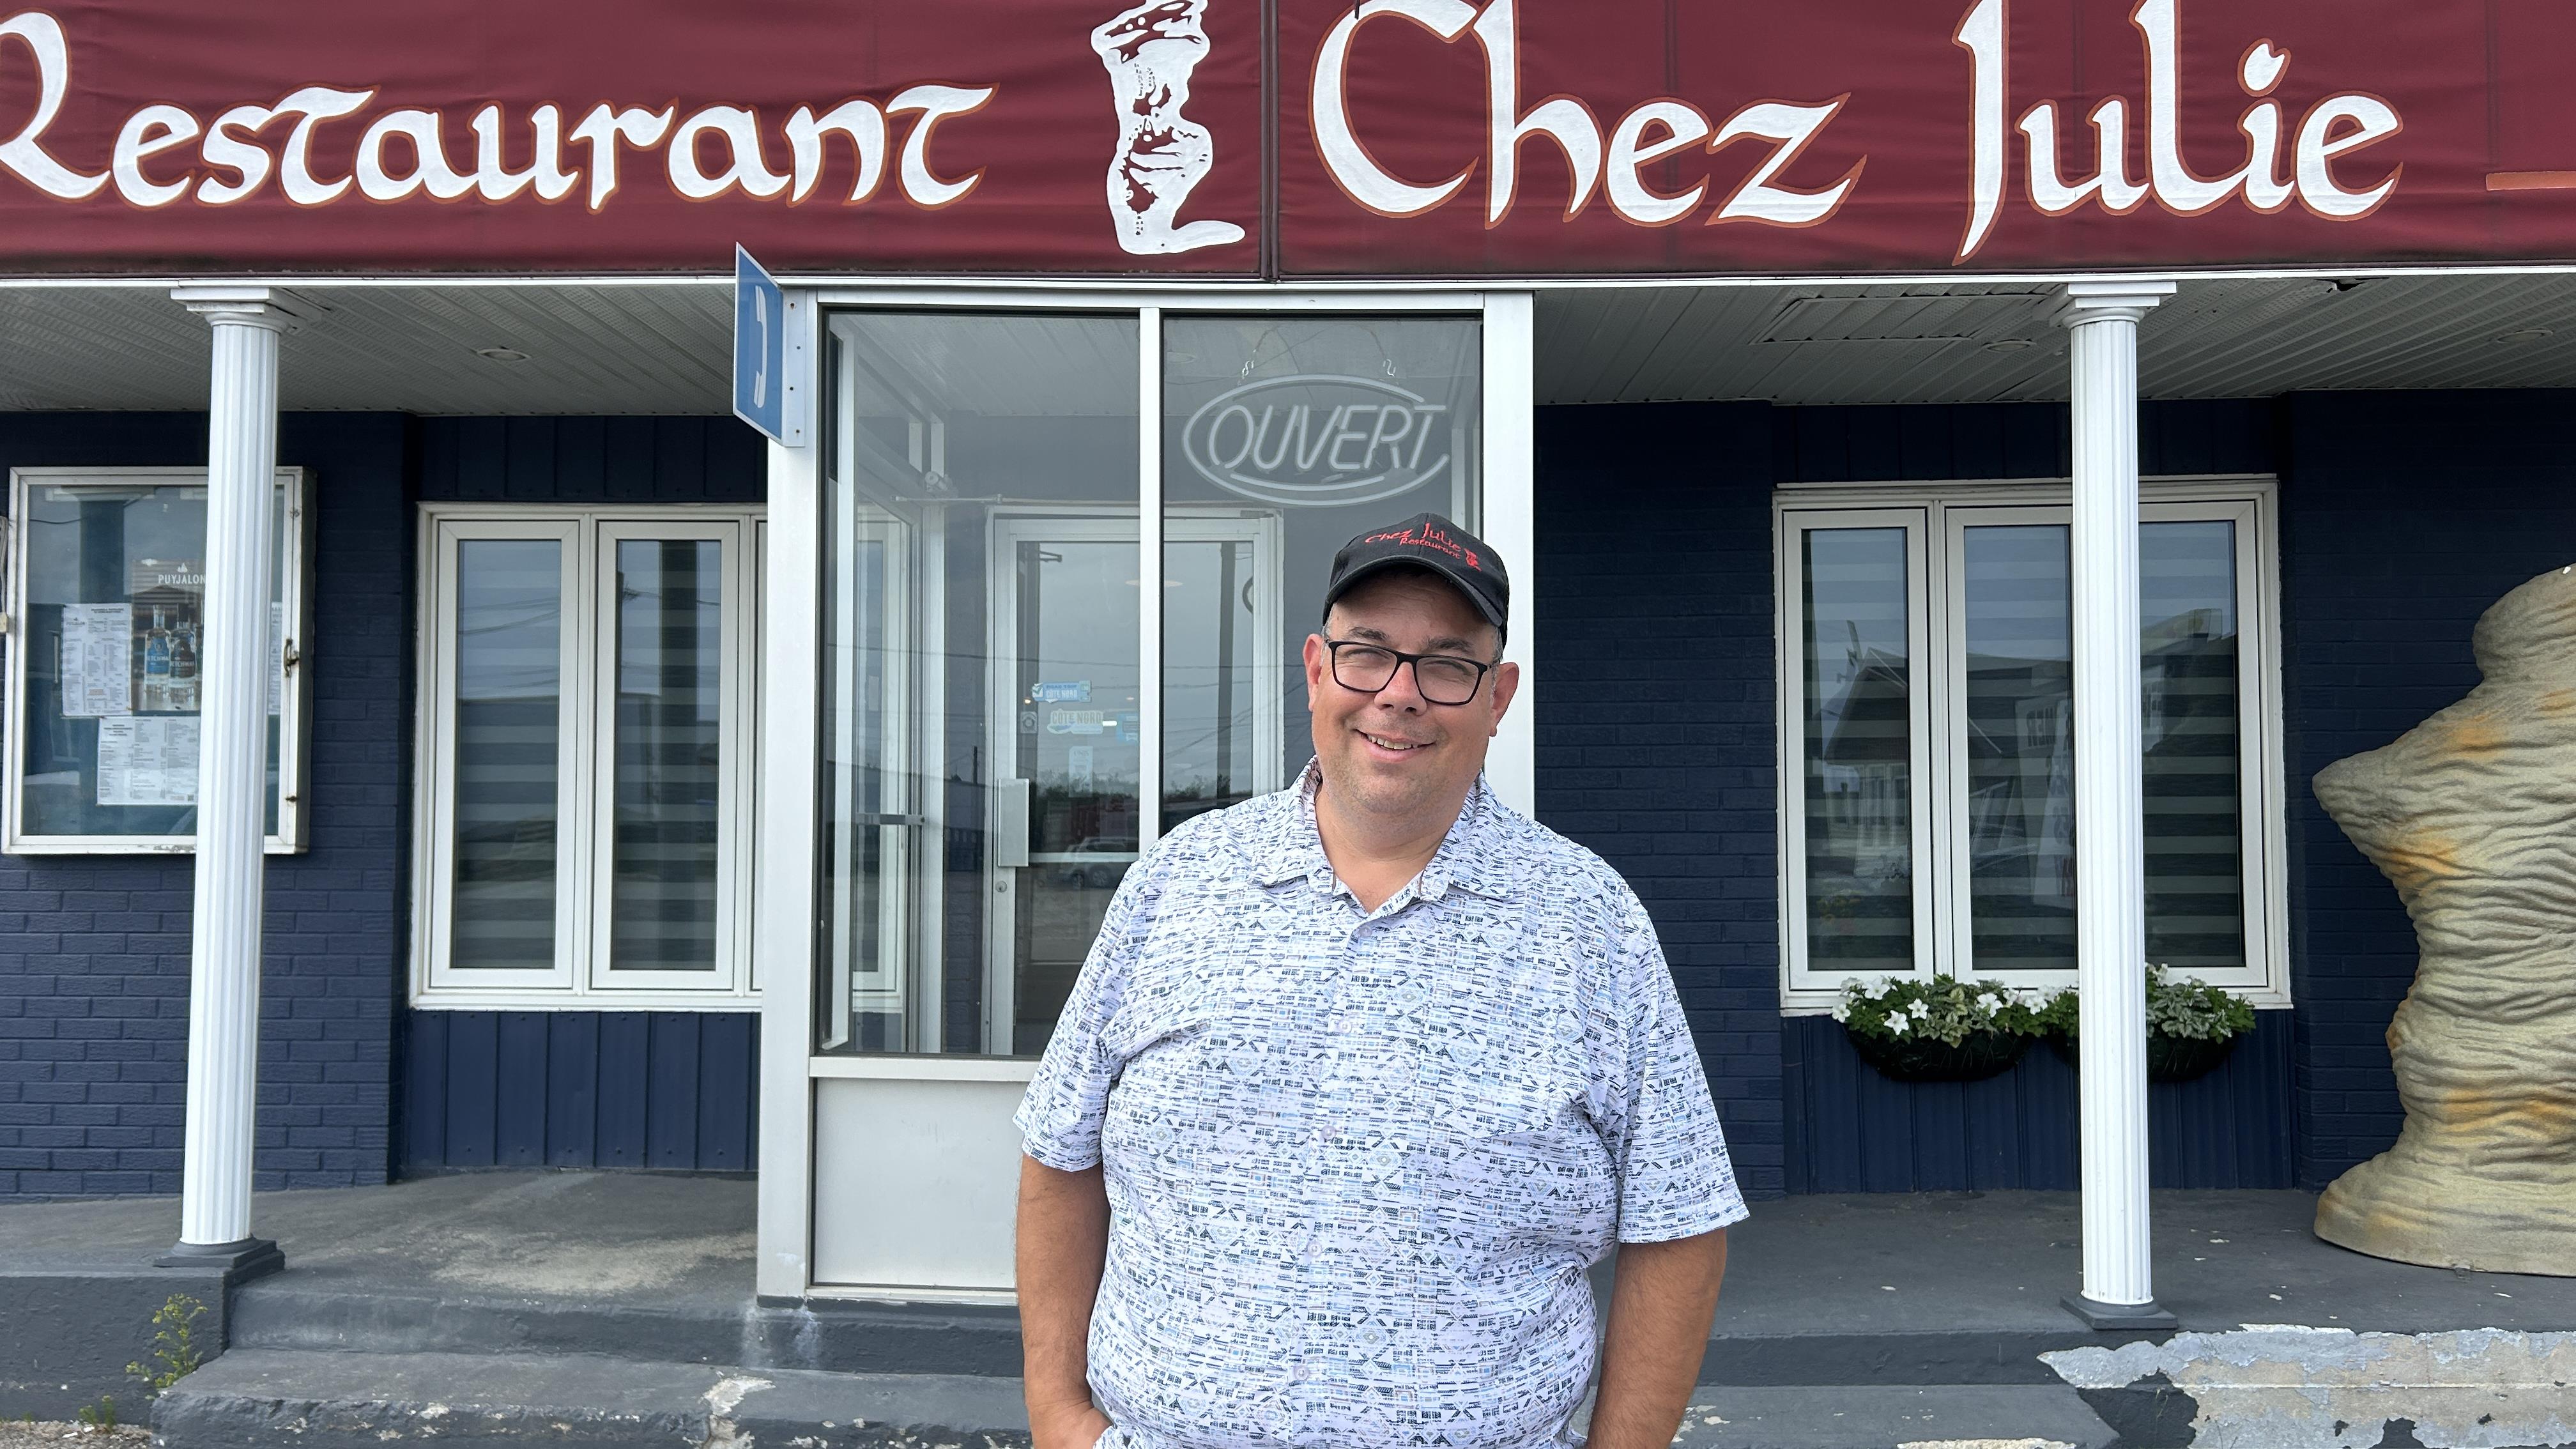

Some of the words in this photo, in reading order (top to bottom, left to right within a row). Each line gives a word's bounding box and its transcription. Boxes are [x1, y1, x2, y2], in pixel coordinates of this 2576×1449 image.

[0, 10, 999, 215] Restaurant
[1308, 0, 1867, 231] Chez
[1951, 0, 2404, 266] Julie
[1208, 404, 1448, 470] OUVERT
[1365, 529, 1413, 544] Chez
[1422, 522, 1462, 552] Julie
[1399, 537, 1462, 560] Restaurant
[158, 574, 206, 585] PUYJALON
[1077, 711, 1101, 724] NORD
